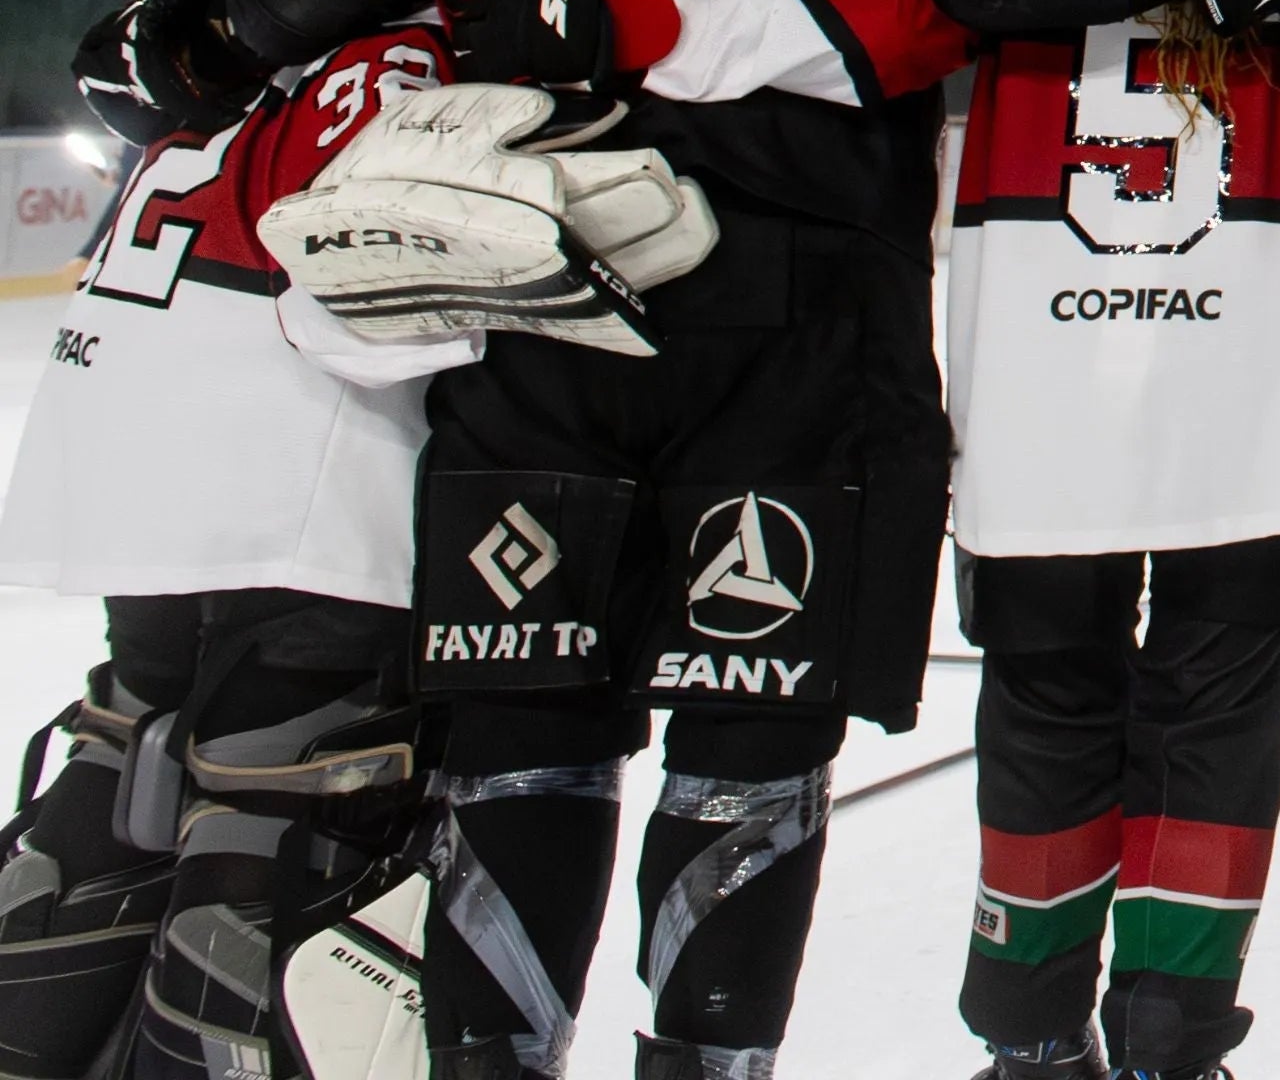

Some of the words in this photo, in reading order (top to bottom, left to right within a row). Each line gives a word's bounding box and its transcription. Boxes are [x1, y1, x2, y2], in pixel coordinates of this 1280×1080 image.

[1062, 18, 1235, 256] 5
[305, 228, 450, 256] CCM
[589, 259, 646, 316] CCM
[1050, 288, 1223, 322] COPIFAC
[425, 622, 541, 662] FAYAT
[649, 652, 814, 697] SANY
[329, 946, 395, 993] RITUAL
